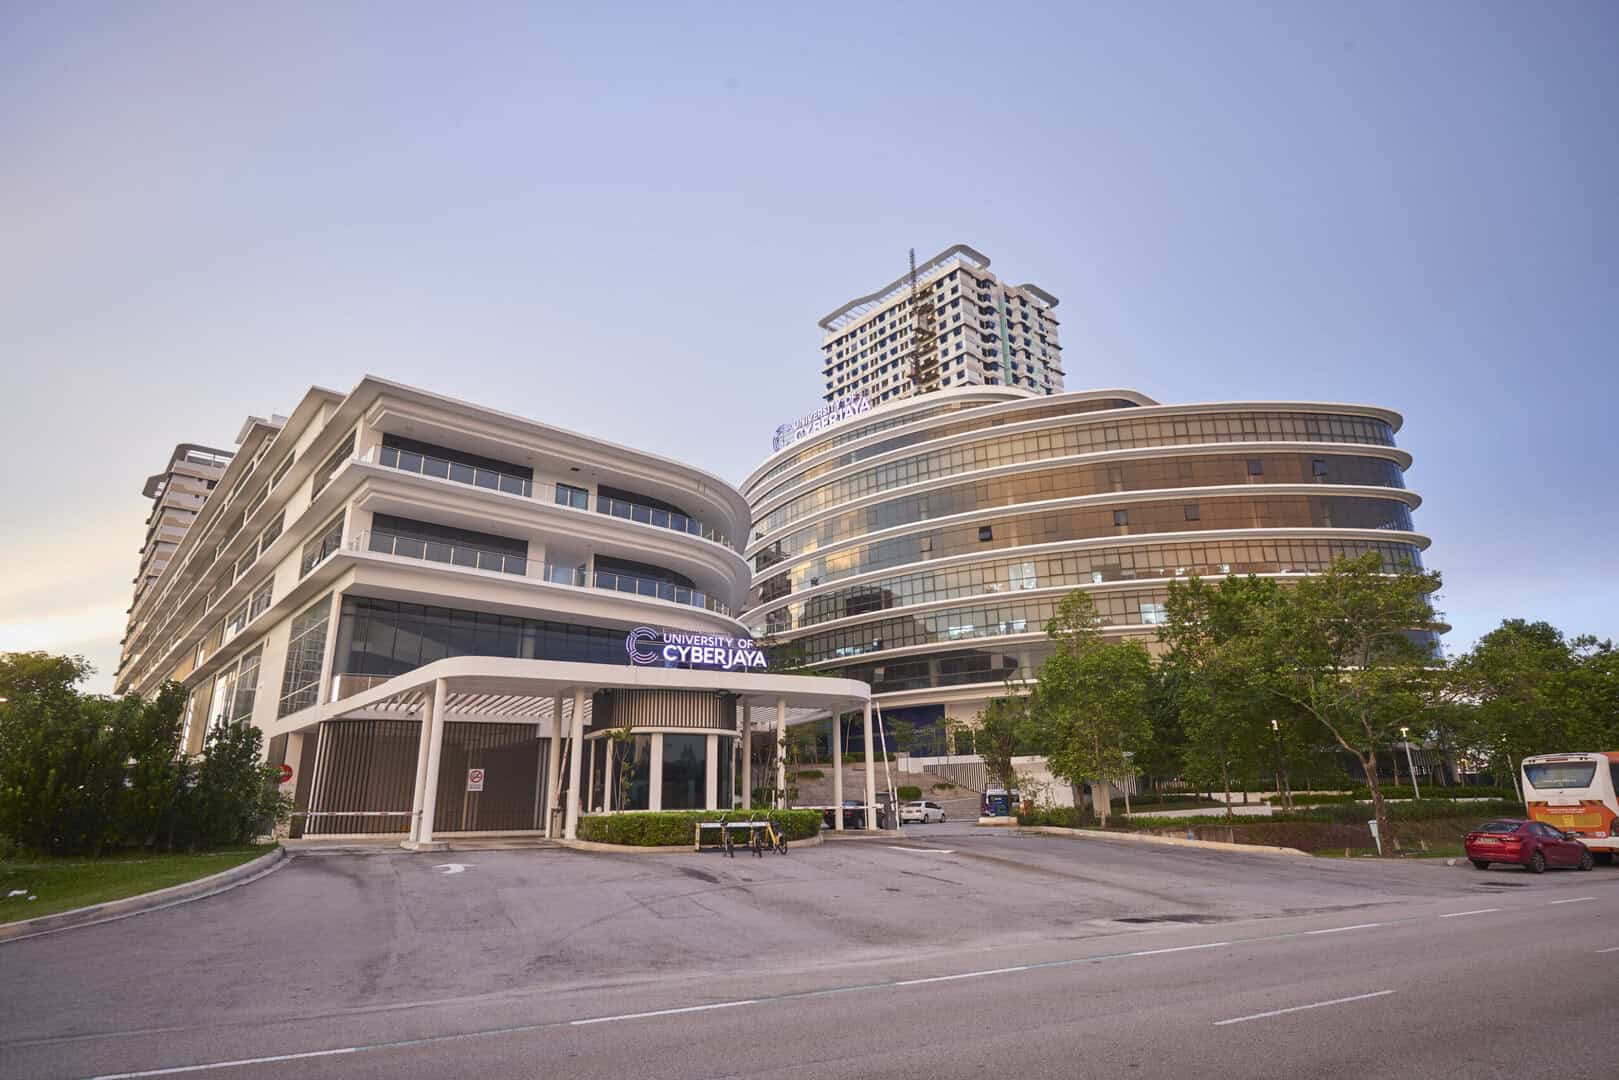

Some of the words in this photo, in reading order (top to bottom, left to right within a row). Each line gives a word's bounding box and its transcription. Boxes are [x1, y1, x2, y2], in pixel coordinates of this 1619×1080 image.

[663, 633, 734, 648] UNIVERSITY
[738, 638, 754, 649] OF
[663, 644, 768, 669] CYBERJAYA
